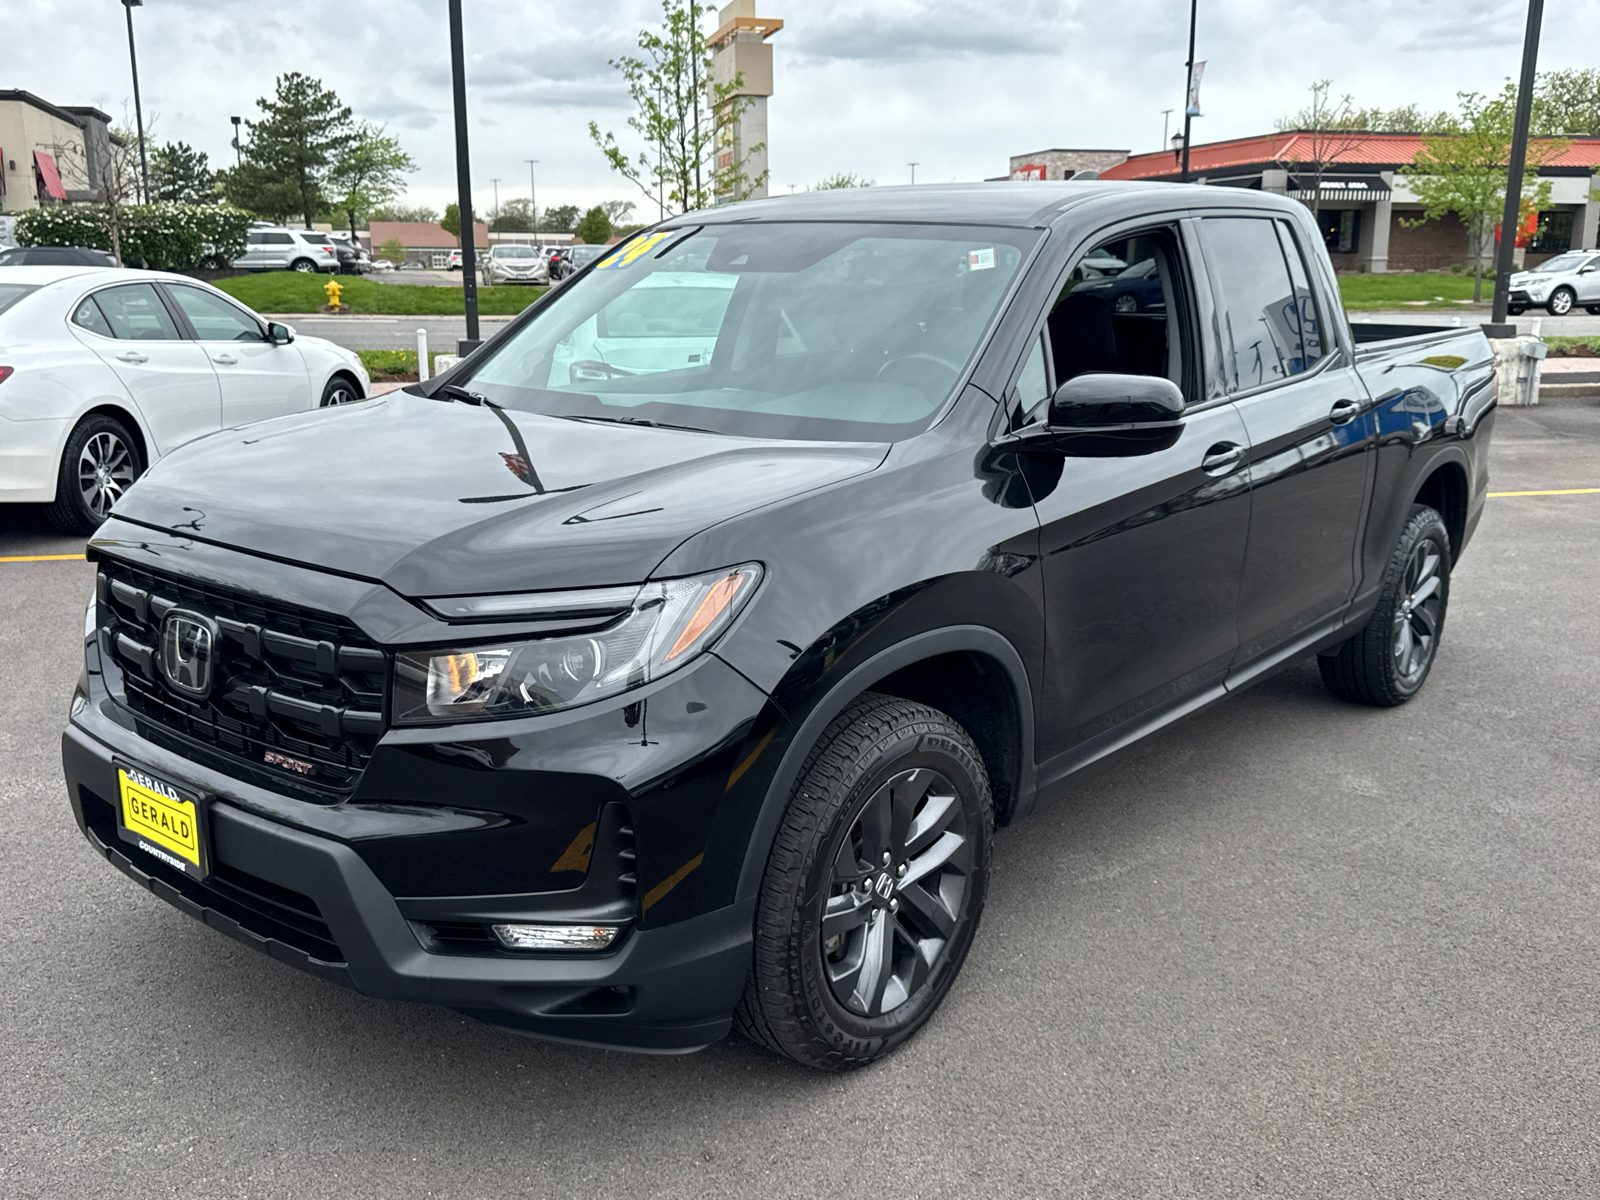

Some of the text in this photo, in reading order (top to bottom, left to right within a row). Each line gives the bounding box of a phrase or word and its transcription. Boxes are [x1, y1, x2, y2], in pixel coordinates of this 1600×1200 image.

[263, 751, 313, 775] SPORT
[130, 769, 178, 802] GERALD
[131, 797, 190, 839] GERALD
[139, 840, 186, 872] COUNTRYSIDE
